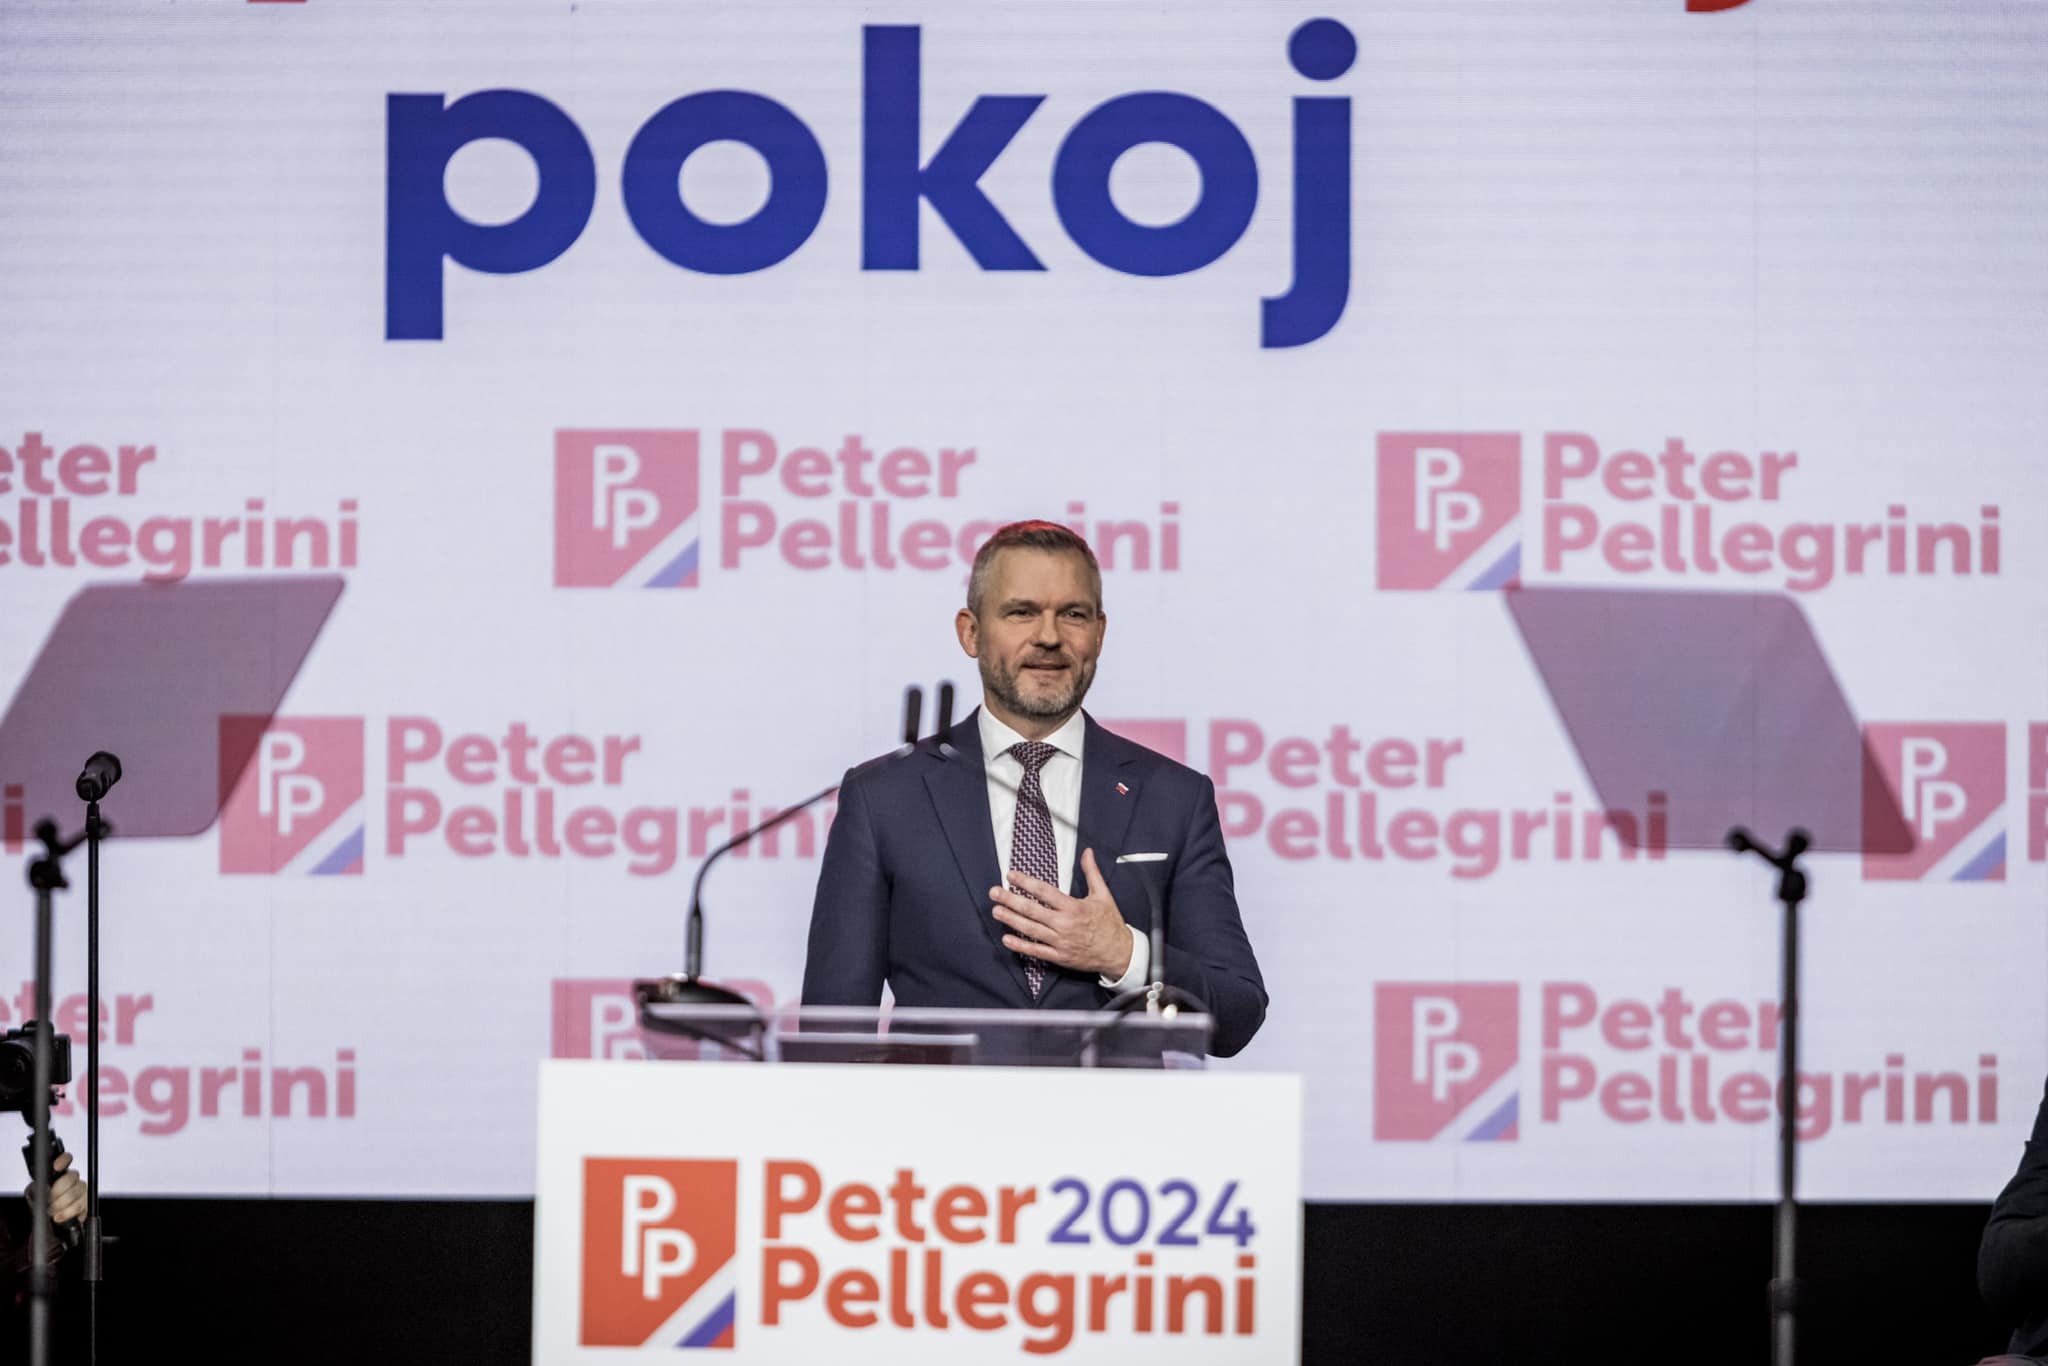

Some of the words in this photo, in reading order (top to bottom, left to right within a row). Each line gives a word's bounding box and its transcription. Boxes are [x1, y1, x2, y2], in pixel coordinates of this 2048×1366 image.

[385, 18, 1358, 349] pokoj
[0, 431, 157, 496] ter
[722, 429, 977, 498] Peter
[1544, 432, 1798, 502] Peter
[0, 497, 358, 584] llegrini
[722, 500, 1180, 586] Pelleni
[1544, 503, 2001, 592] Pellegrini
[386, 717, 641, 786] Peter
[1209, 720, 1464, 789] Peter
[1542, 982, 1798, 1051] Peter
[1542, 1054, 1998, 1142] Pellegrini
[761, 1159, 1037, 1244] Peter
[1048, 1177, 1257, 1247] 2024
[759, 1246, 1258, 1356] Pellegrini
